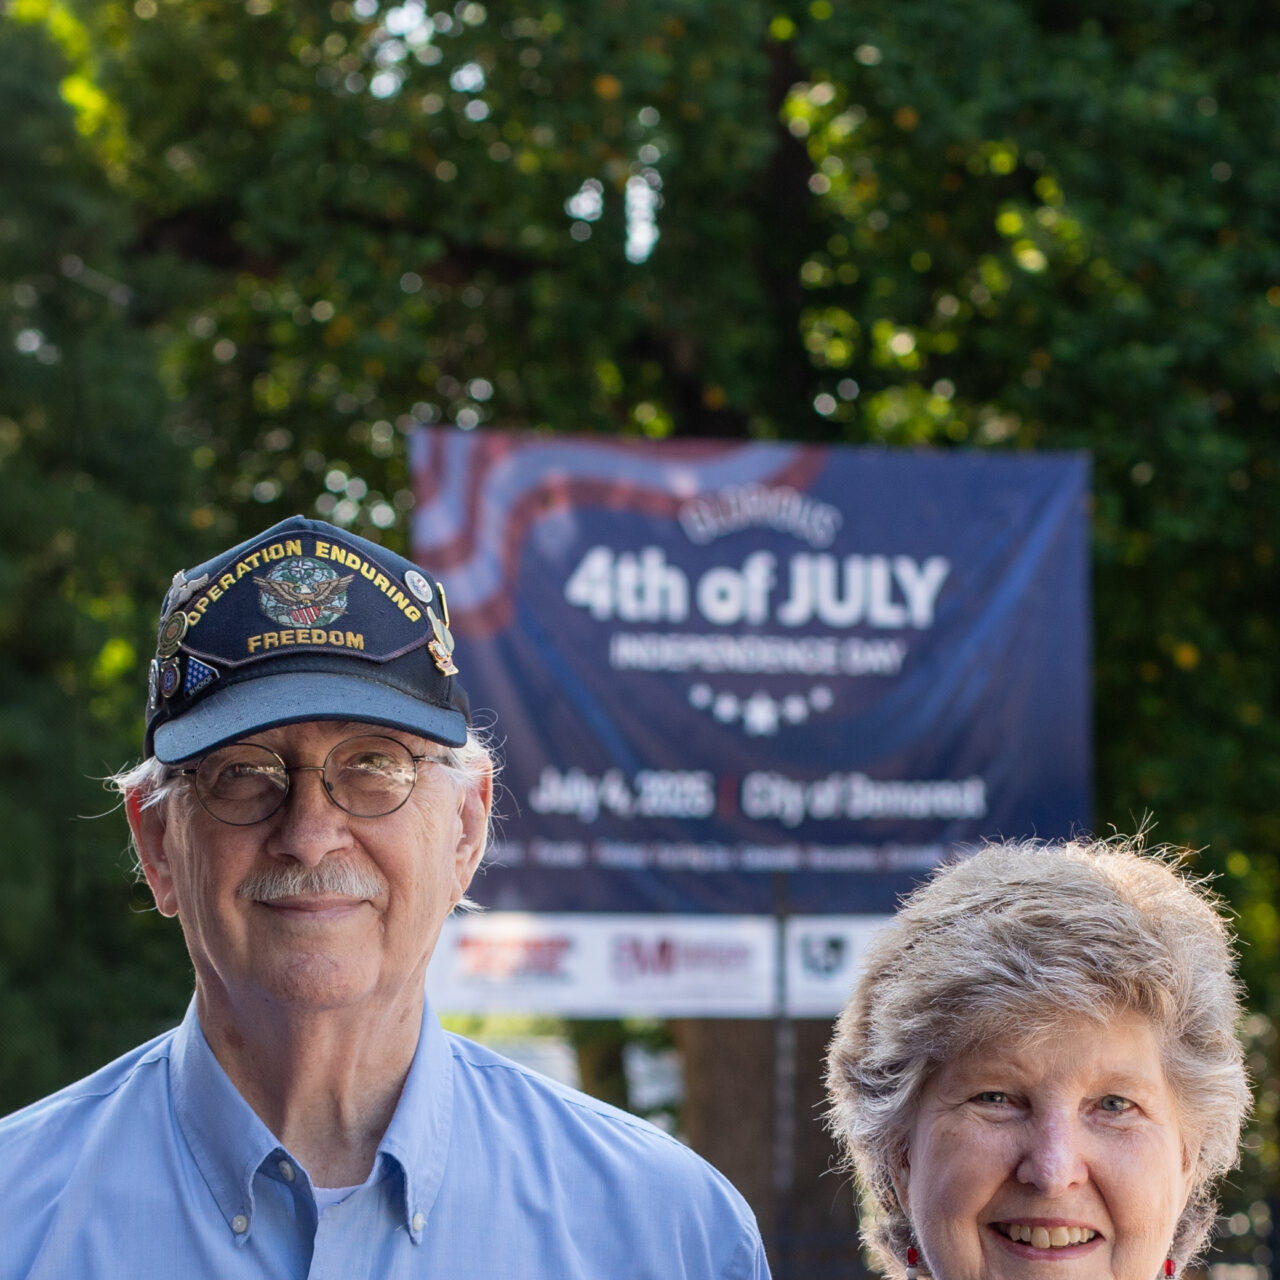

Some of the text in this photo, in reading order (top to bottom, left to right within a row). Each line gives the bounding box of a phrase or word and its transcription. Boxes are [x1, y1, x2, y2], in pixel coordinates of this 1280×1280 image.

[187, 540, 422, 626] OPERATION ENDURING
[566, 546, 949, 628] 4th of JULY
[248, 629, 365, 653] FREEDOM
[610, 633, 907, 674] INDEPENDENCE DAY
[530, 768, 599, 822] July
[635, 771, 715, 818] 2025
[741, 772, 804, 827] City
[807, 773, 846, 820] of
